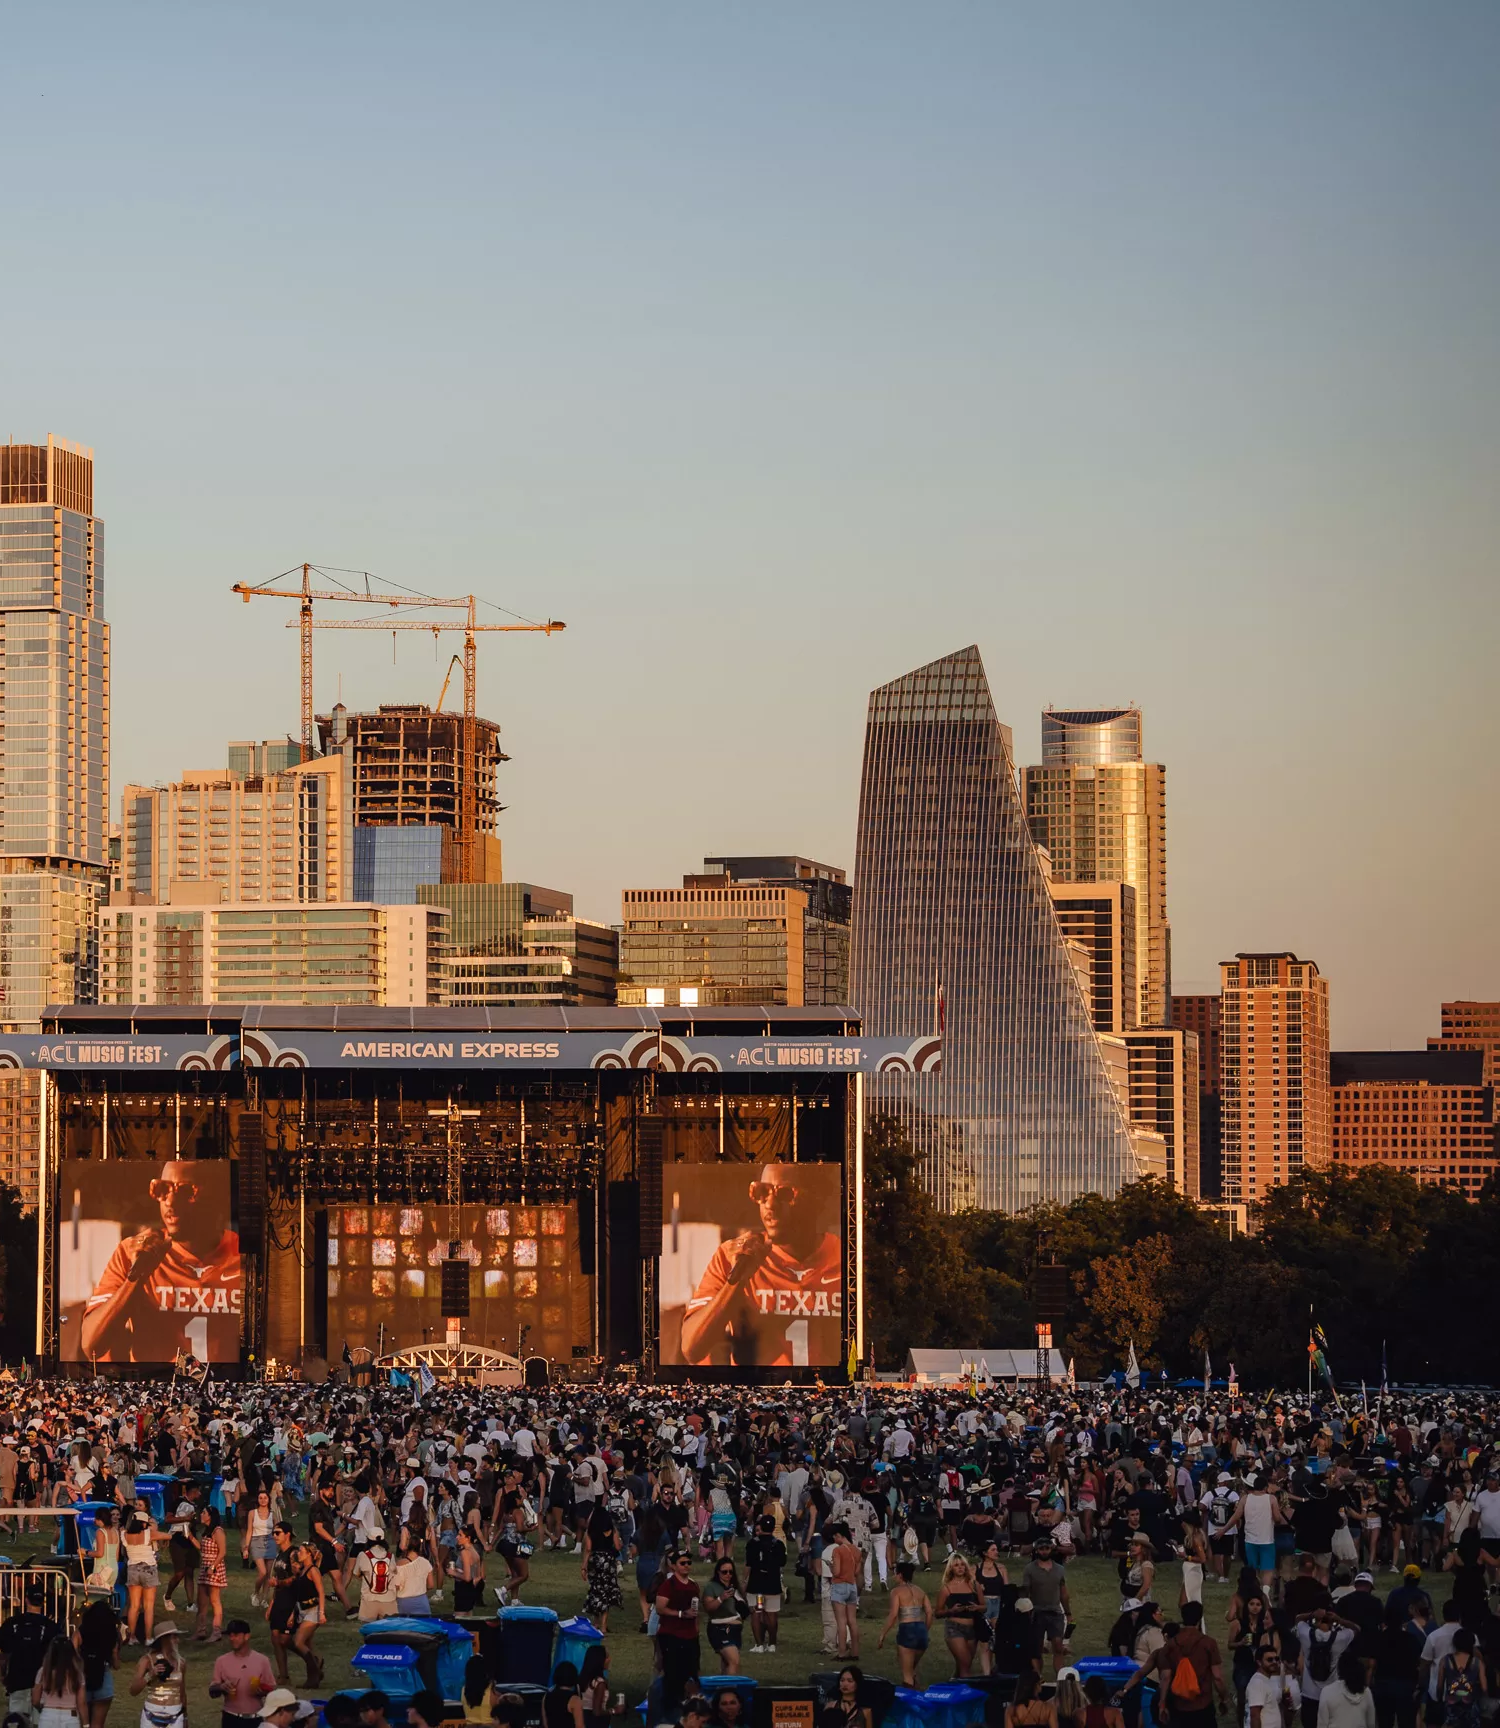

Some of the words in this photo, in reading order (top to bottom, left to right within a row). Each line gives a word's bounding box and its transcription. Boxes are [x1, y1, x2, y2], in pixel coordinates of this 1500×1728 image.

[38, 1045, 76, 1063] ACL
[78, 1045, 125, 1063] MUSIC
[128, 1045, 162, 1063] FEST
[340, 1042, 453, 1058] AMERICAN
[461, 1042, 560, 1058] EXPRESS
[737, 1048, 775, 1065] ACL
[777, 1048, 824, 1066] MUSIC
[827, 1048, 861, 1066] FEST
[155, 1285, 240, 1314] TEXAS
[755, 1288, 842, 1317] TEXAS
[184, 1316, 208, 1363] 1
[785, 1319, 809, 1367] 1
